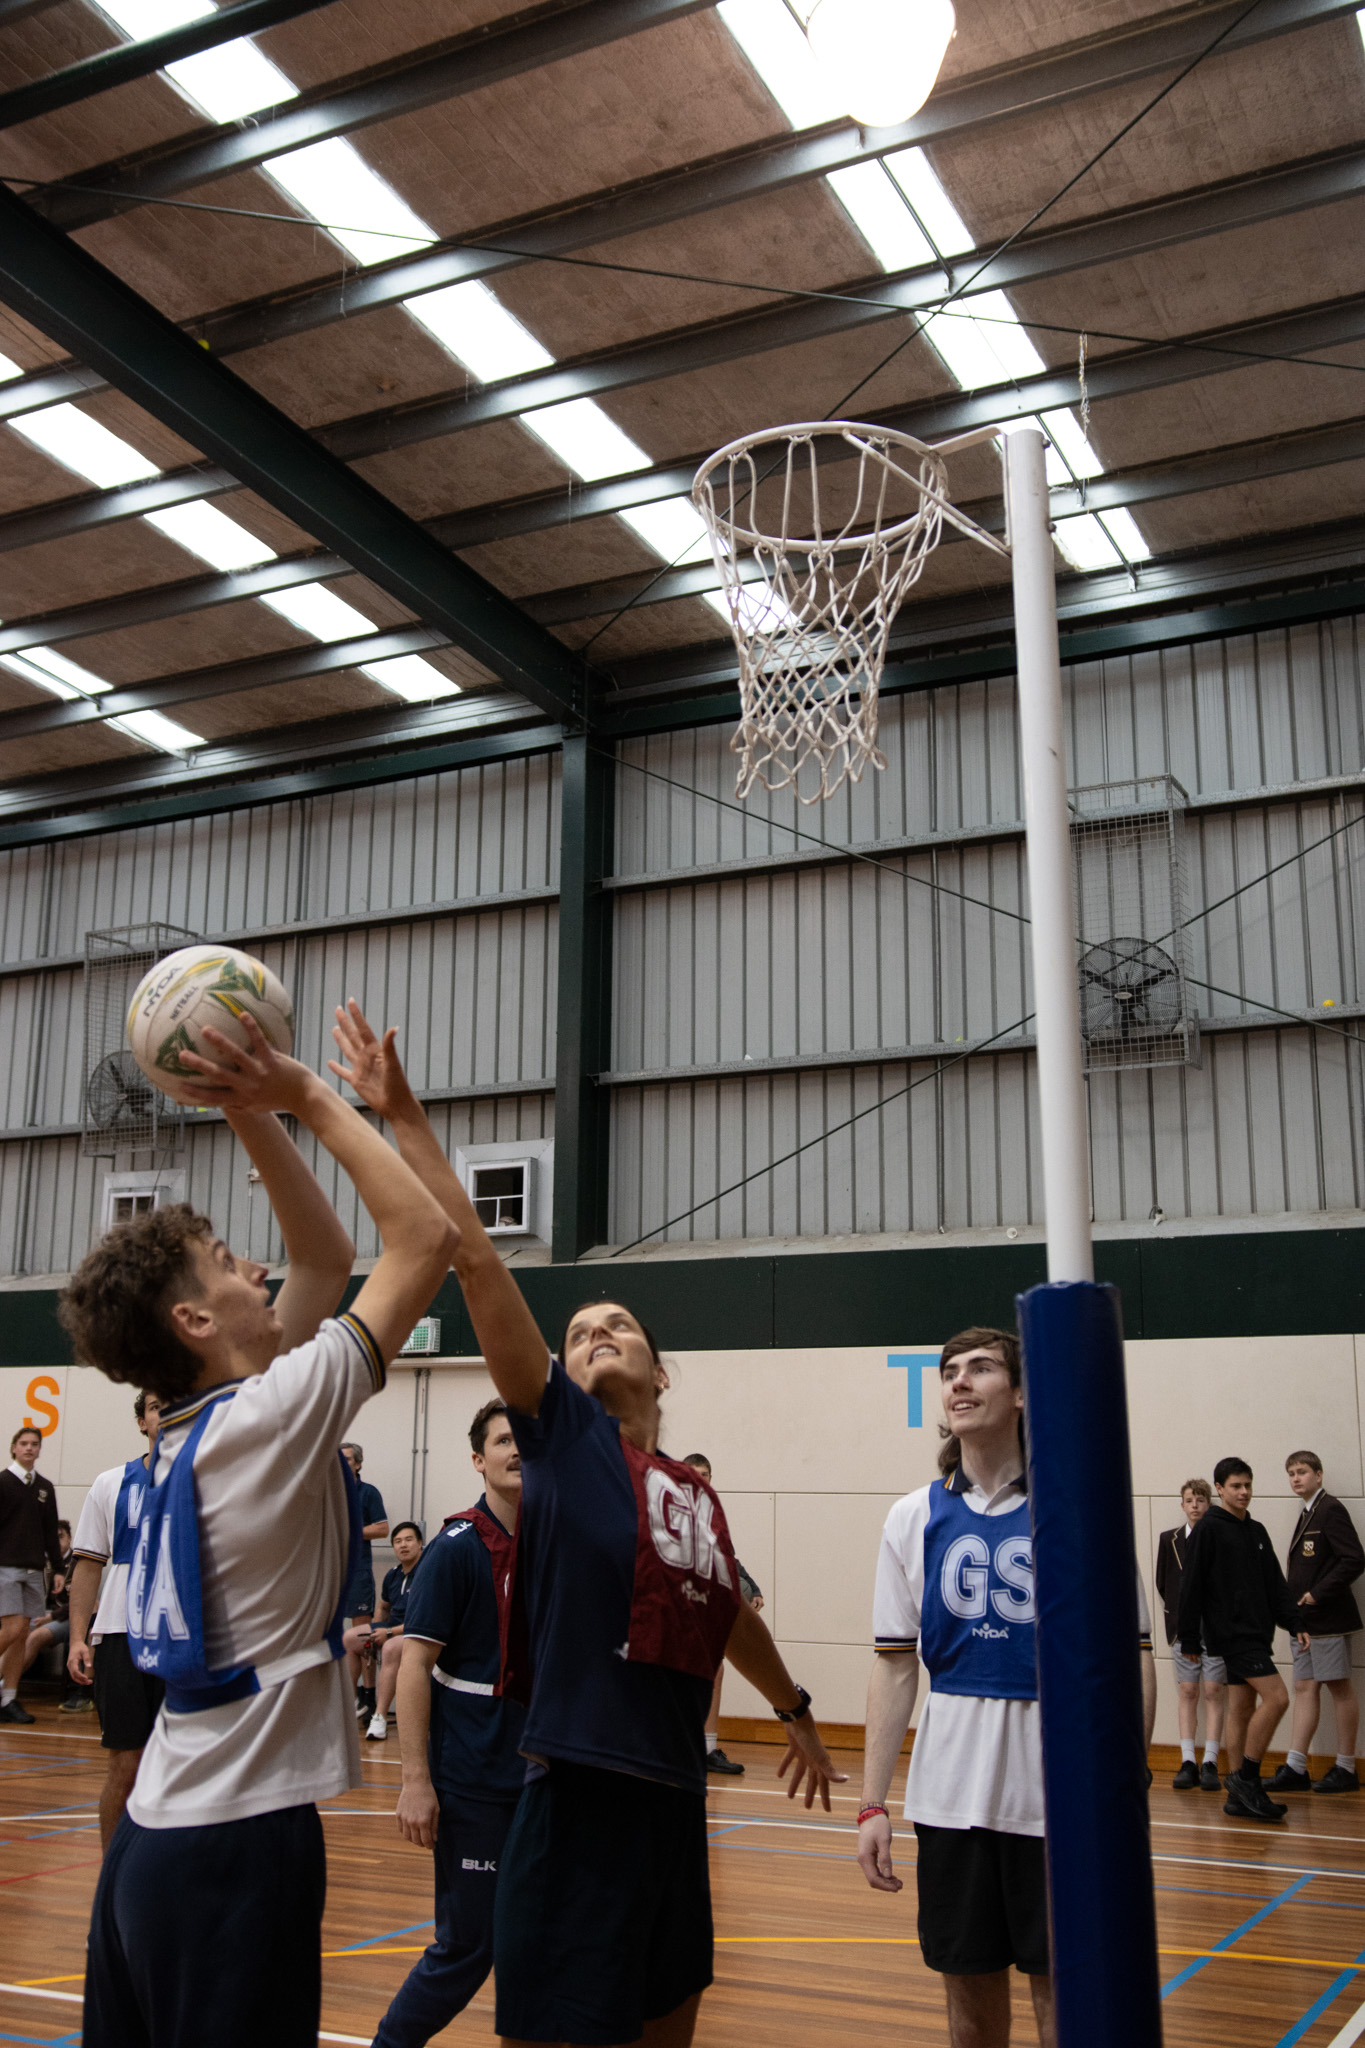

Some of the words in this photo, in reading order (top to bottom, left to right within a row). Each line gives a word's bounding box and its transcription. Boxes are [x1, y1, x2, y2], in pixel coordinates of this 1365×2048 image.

[169, 986, 199, 1020] NETBALL
[23, 1375, 60, 1438] S
[446, 1521, 474, 1537] BLK
[644, 1467, 732, 1590] GK
[941, 1534, 1036, 1624] GS
[972, 1622, 1009, 1640] NYDA
[461, 1858, 497, 1871] BLK
